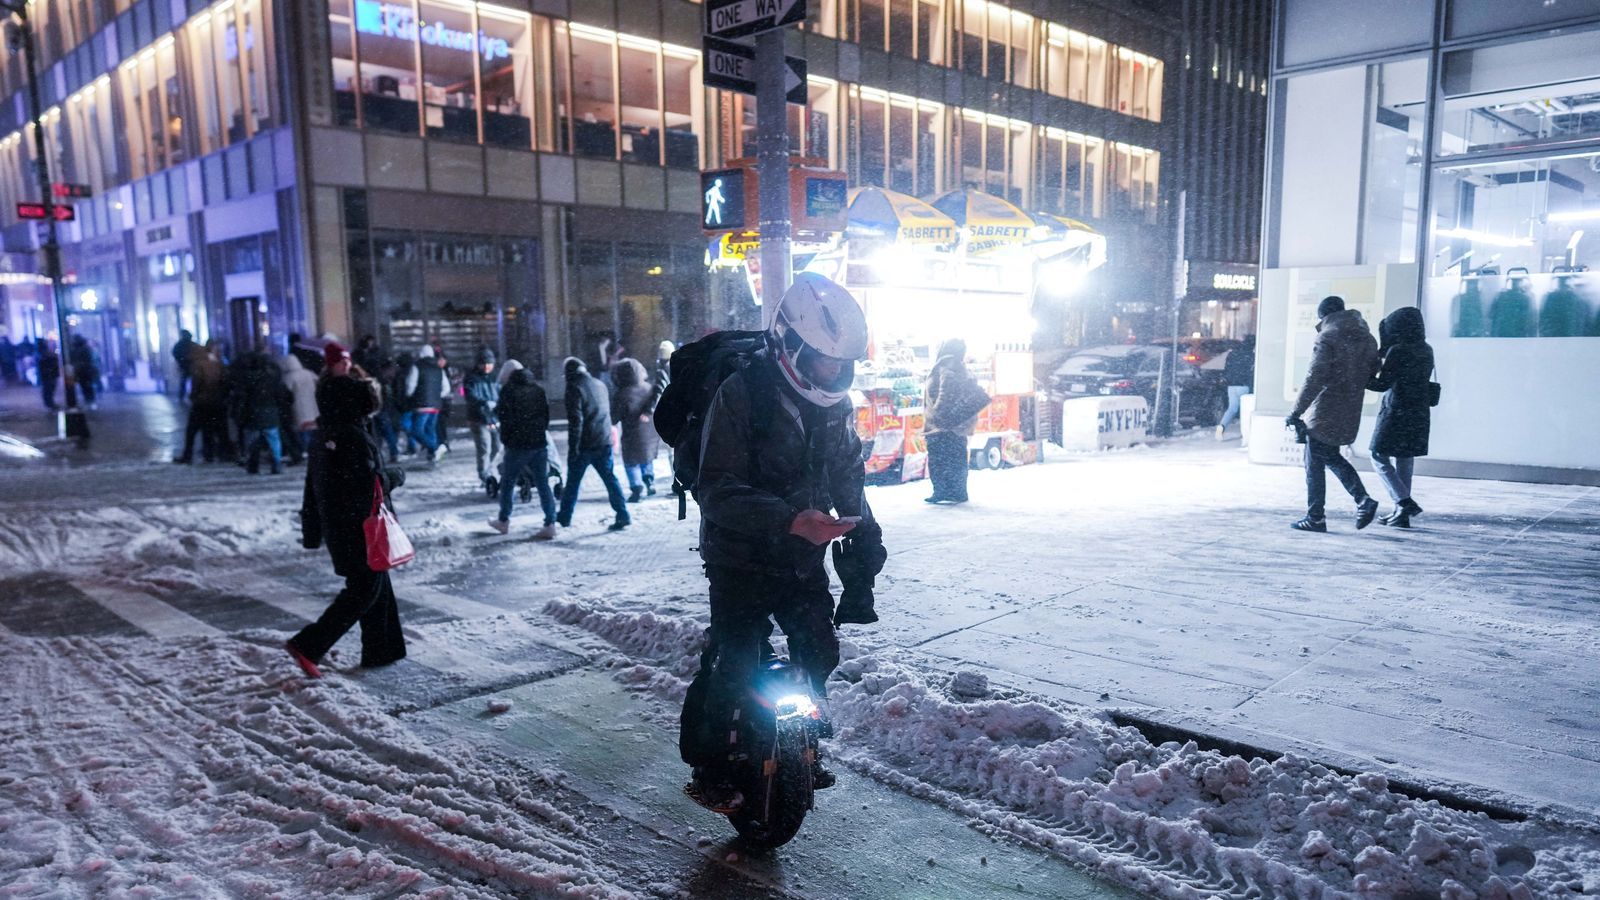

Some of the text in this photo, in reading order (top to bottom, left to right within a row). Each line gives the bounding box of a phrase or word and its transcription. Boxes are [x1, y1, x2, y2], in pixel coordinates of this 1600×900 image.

[716, 0, 783, 29] ONE WAY
[715, 54, 744, 77] ONE
[903, 227, 953, 239] SABRETT
[969, 225, 1030, 238] SABRETT
[1213, 273, 1256, 290] SOULCYCLE
[1105, 409, 1141, 432] NYPD
